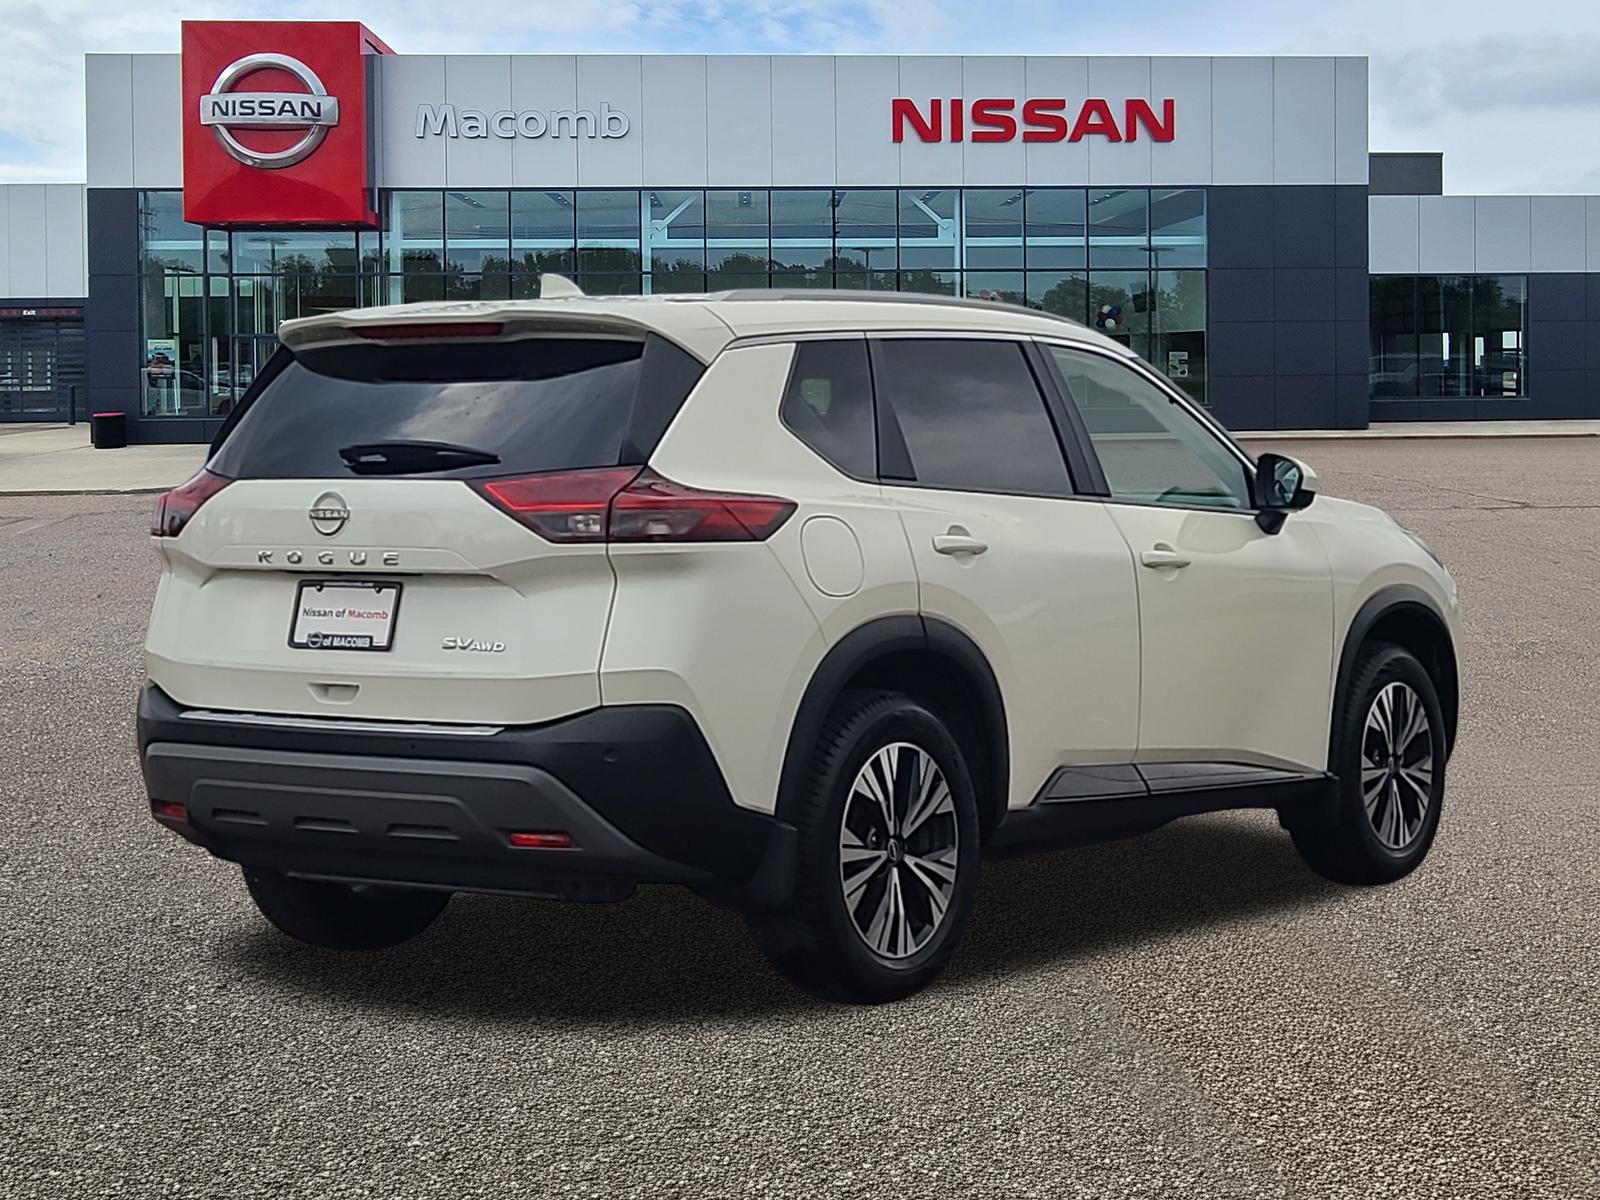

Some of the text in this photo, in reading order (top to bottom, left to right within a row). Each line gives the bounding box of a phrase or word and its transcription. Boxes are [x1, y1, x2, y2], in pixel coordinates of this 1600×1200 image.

[211, 101, 321, 118] NISSAN
[415, 102, 631, 139] Macomb
[891, 98, 1175, 143] NISSAN
[258, 551, 399, 565] ROGUE
[303, 607, 388, 619] Nissan of Macomb
[332, 637, 370, 647] MACOMB
